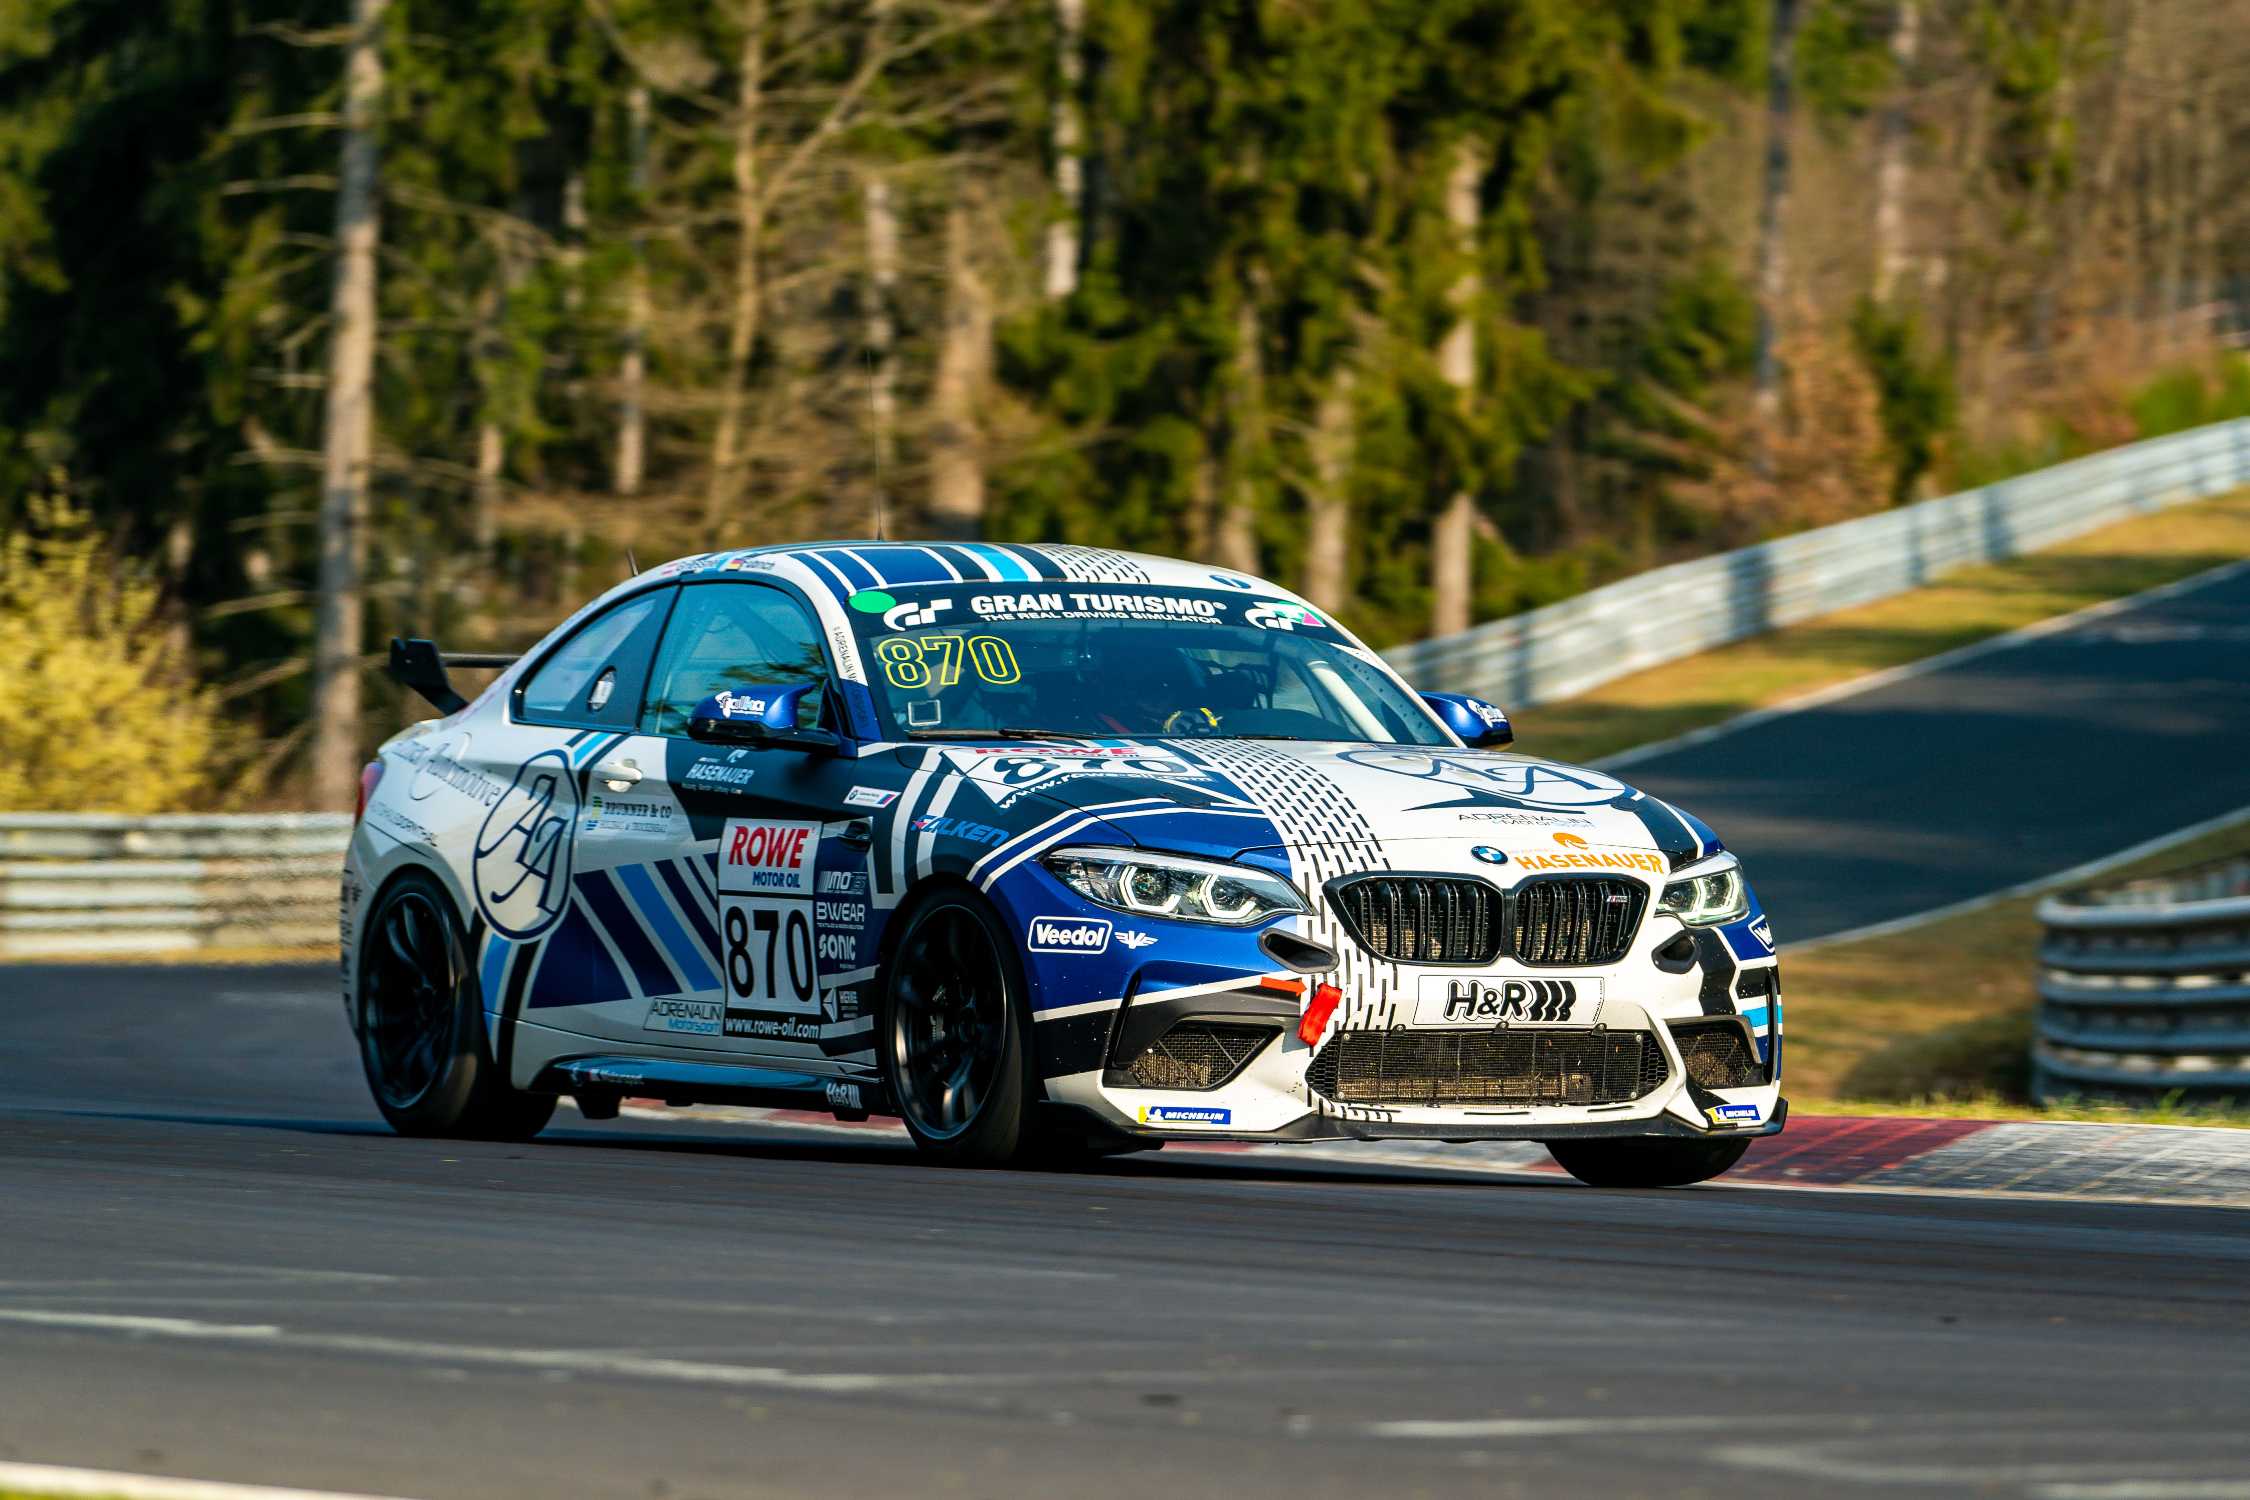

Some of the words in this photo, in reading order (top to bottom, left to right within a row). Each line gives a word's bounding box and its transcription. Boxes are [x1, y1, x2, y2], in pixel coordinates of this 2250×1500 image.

[970, 593, 1063, 614] GRAN
[980, 613, 1016, 622] THE
[1017, 612, 1062, 620] REAL
[1063, 611, 1130, 620] DRIVING
[1132, 612, 1223, 625] SIMULATOR
[878, 635, 1022, 689] 870
[685, 763, 755, 785] HASENAUER
[1457, 812, 1593, 826] ADRENALIN
[911, 814, 1011, 848] FALKEN
[728, 825, 810, 869] ROWE
[1513, 850, 1664, 874] HASENAUER
[752, 871, 785, 887] MOTOR
[786, 872, 801, 888] OIL
[816, 901, 865, 923] BWEAR
[1036, 923, 1106, 947] Veedol
[725, 905, 815, 1002] 870
[651, 1000, 721, 1020] ADRENALIN
[1445, 979, 1530, 1020] H&R
[725, 1017, 819, 1039] www.rowe-oil.com
[1164, 1111, 1225, 1121] MICHELIN
